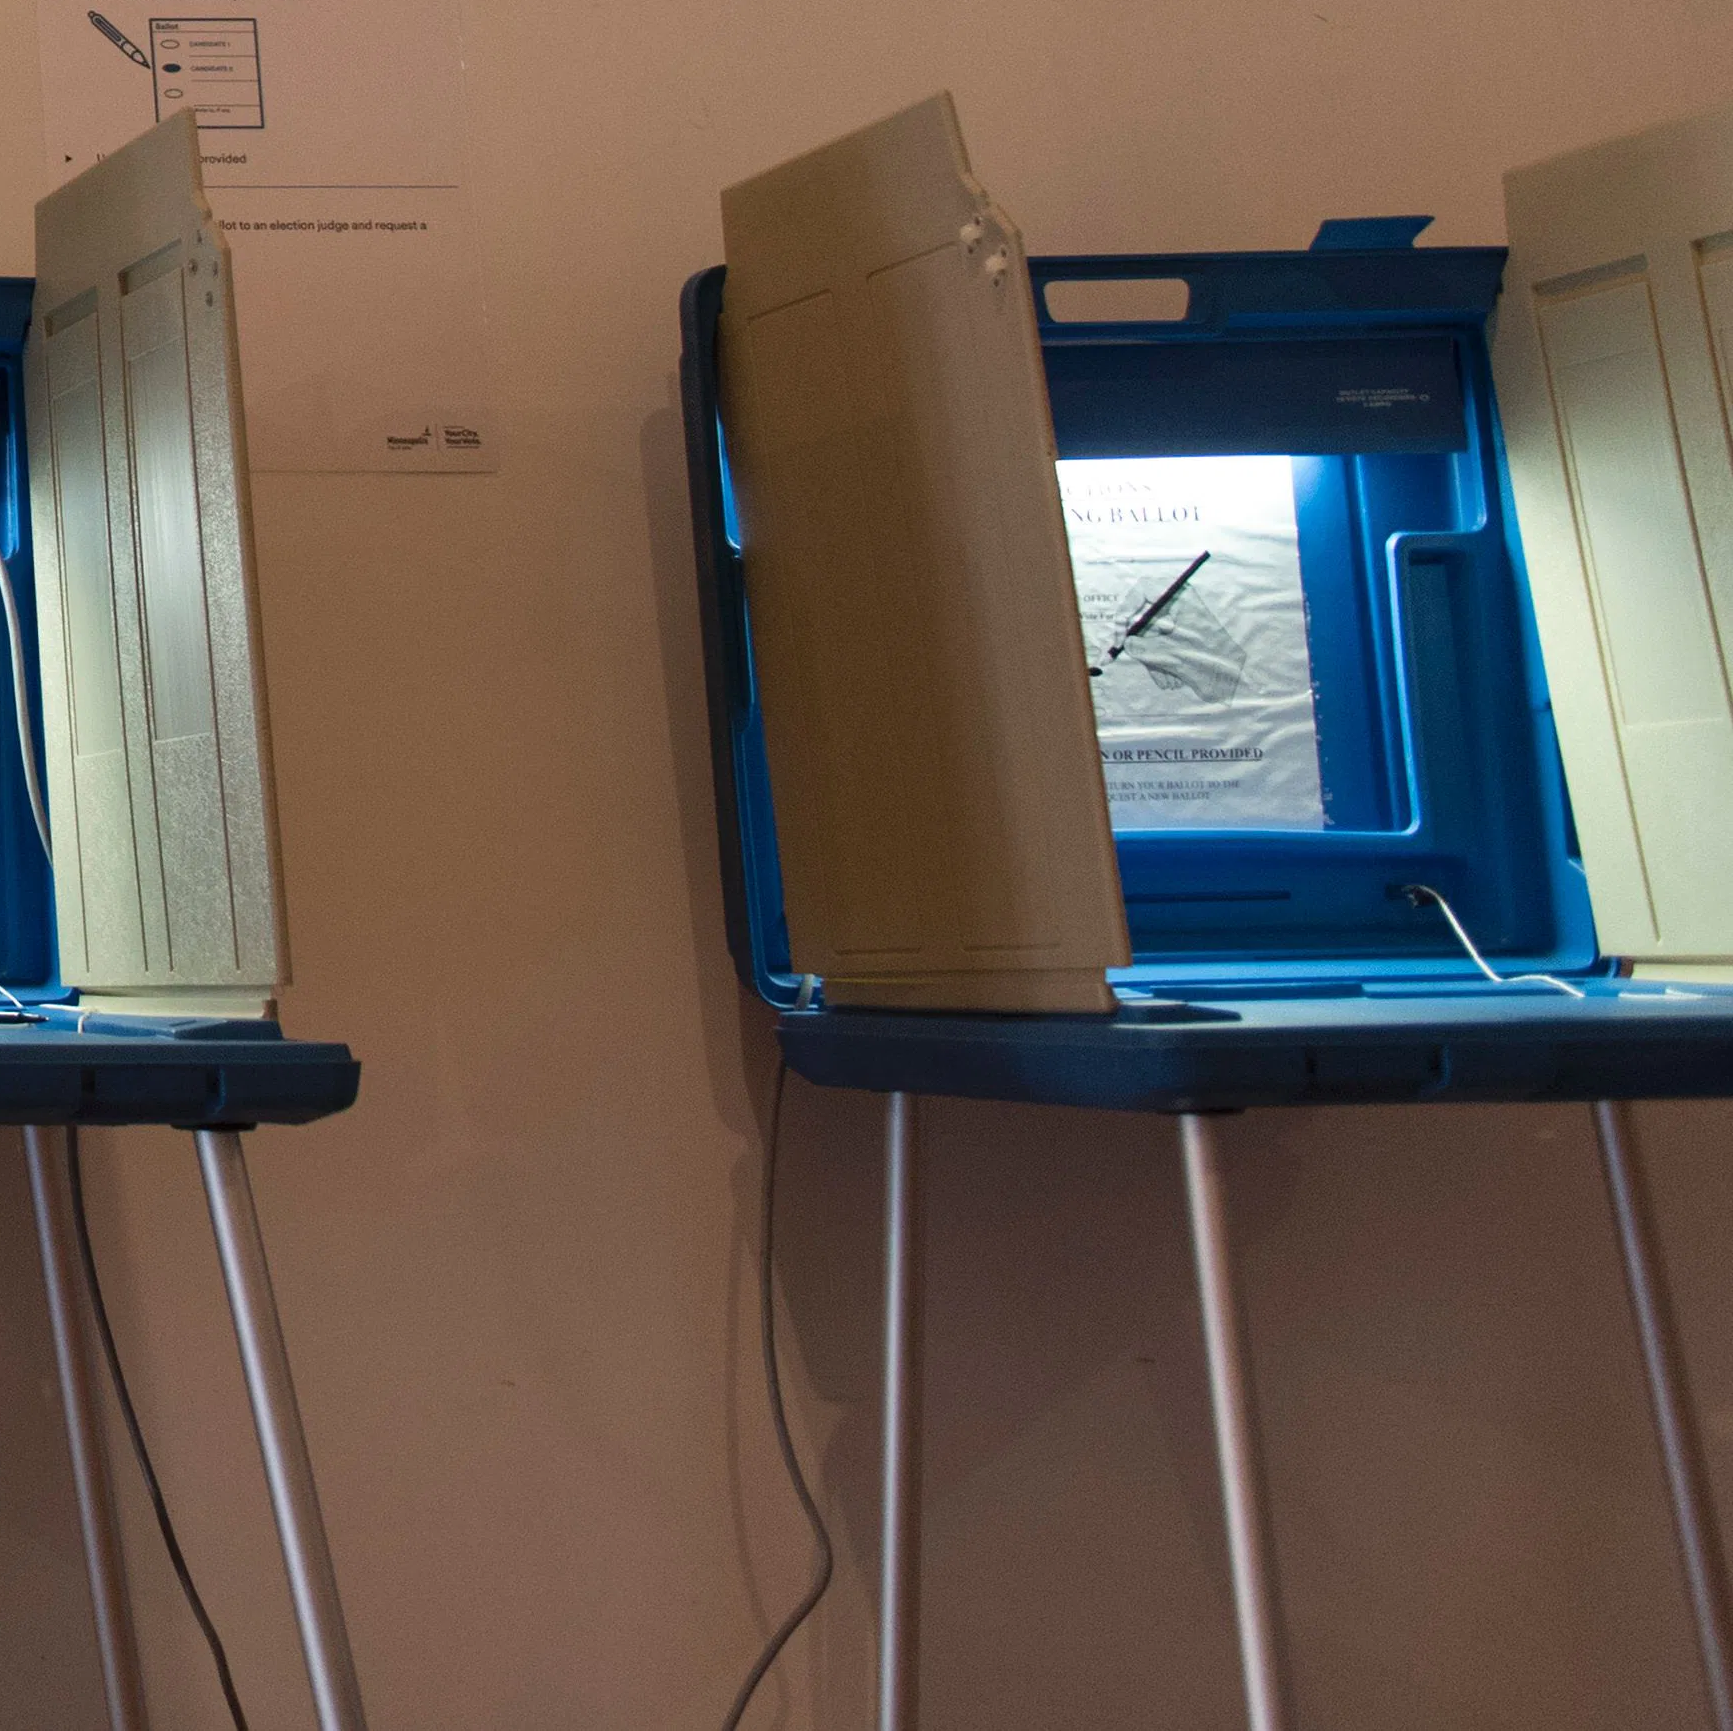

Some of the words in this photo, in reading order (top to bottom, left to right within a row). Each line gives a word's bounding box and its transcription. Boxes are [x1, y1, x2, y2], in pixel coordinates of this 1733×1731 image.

[240, 220, 250, 230] to
[270, 220, 314, 230] election
[317, 220, 349, 232] judge
[352, 220, 372, 230] and
[375, 220, 420, 232] request
[1111, 506, 1199, 522] BALLOT
[1113, 750, 1133, 760] OR
[1137, 749, 1187, 760] PENCIL
[1191, 747, 1263, 759] PROVIDED
